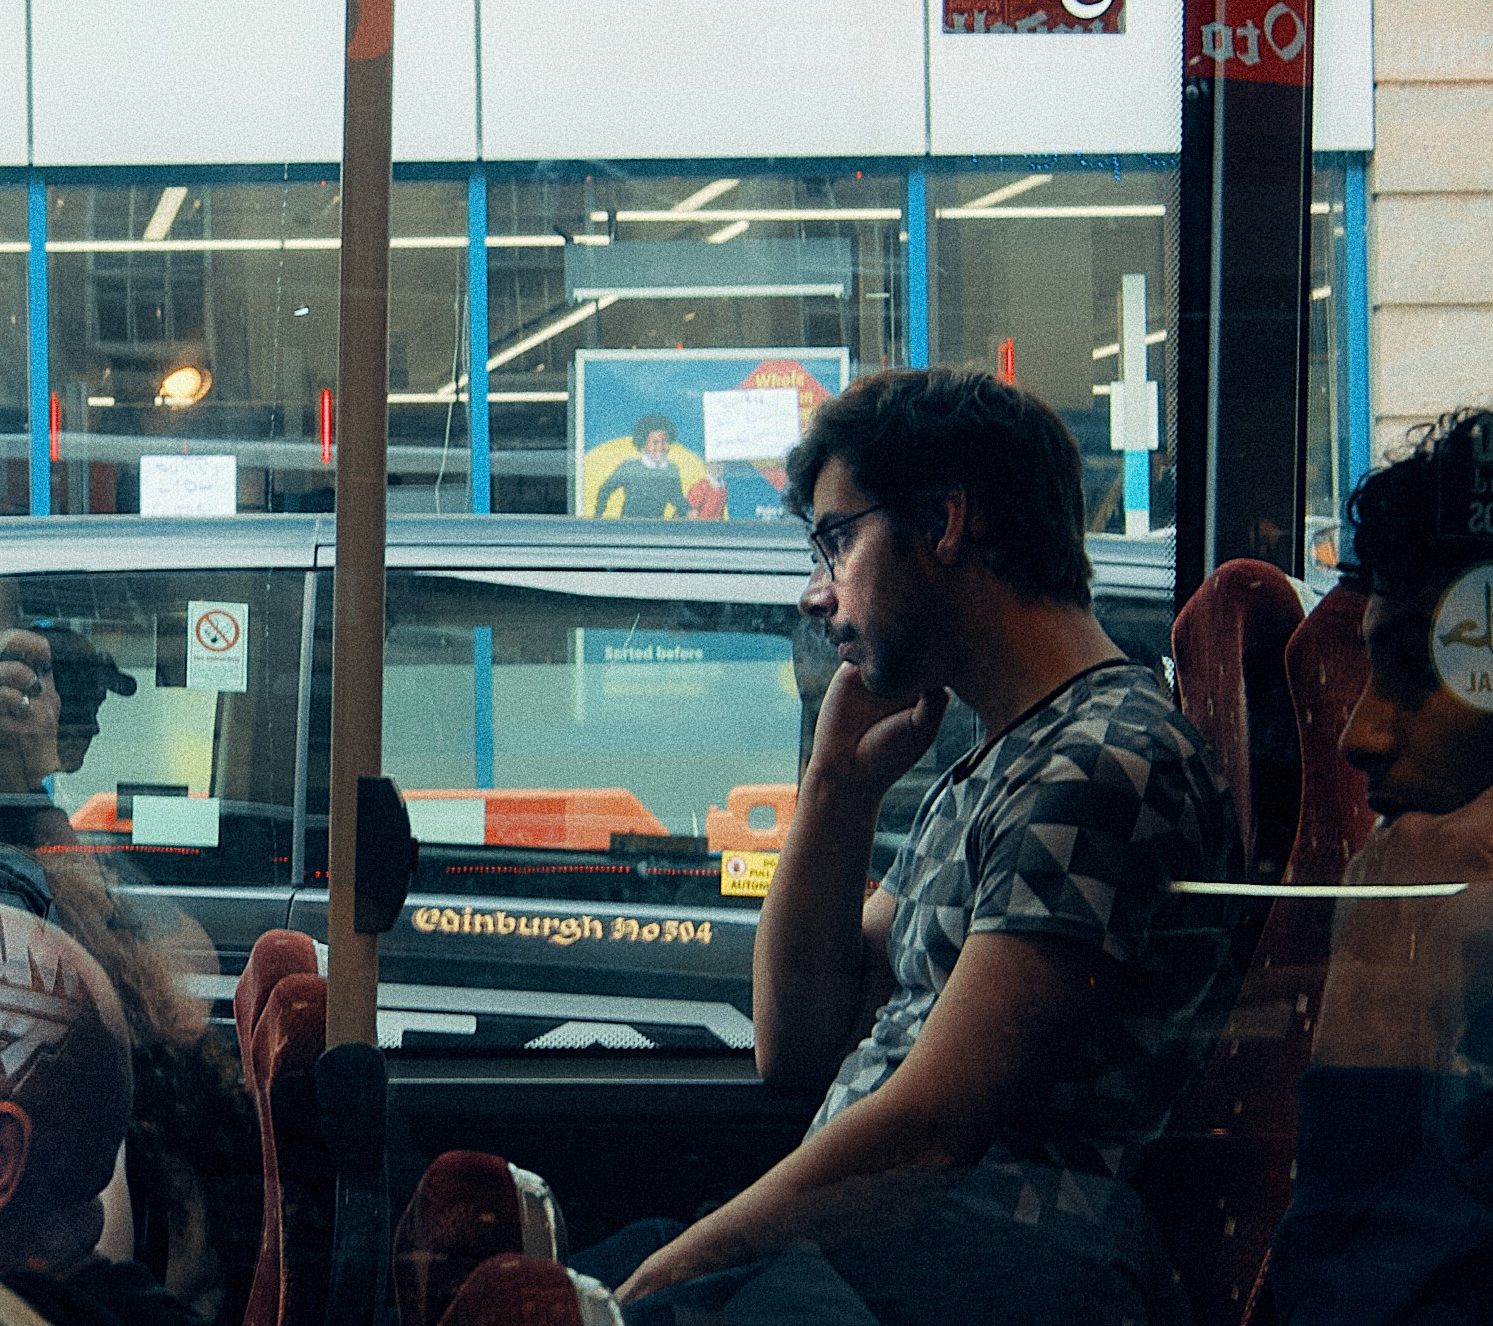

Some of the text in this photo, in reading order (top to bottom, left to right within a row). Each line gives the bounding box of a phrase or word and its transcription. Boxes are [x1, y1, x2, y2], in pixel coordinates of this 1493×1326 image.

[754, 371, 805, 388] Whole
[656, 644, 705, 661] before
[414, 906, 603, 946] Edinburgh
